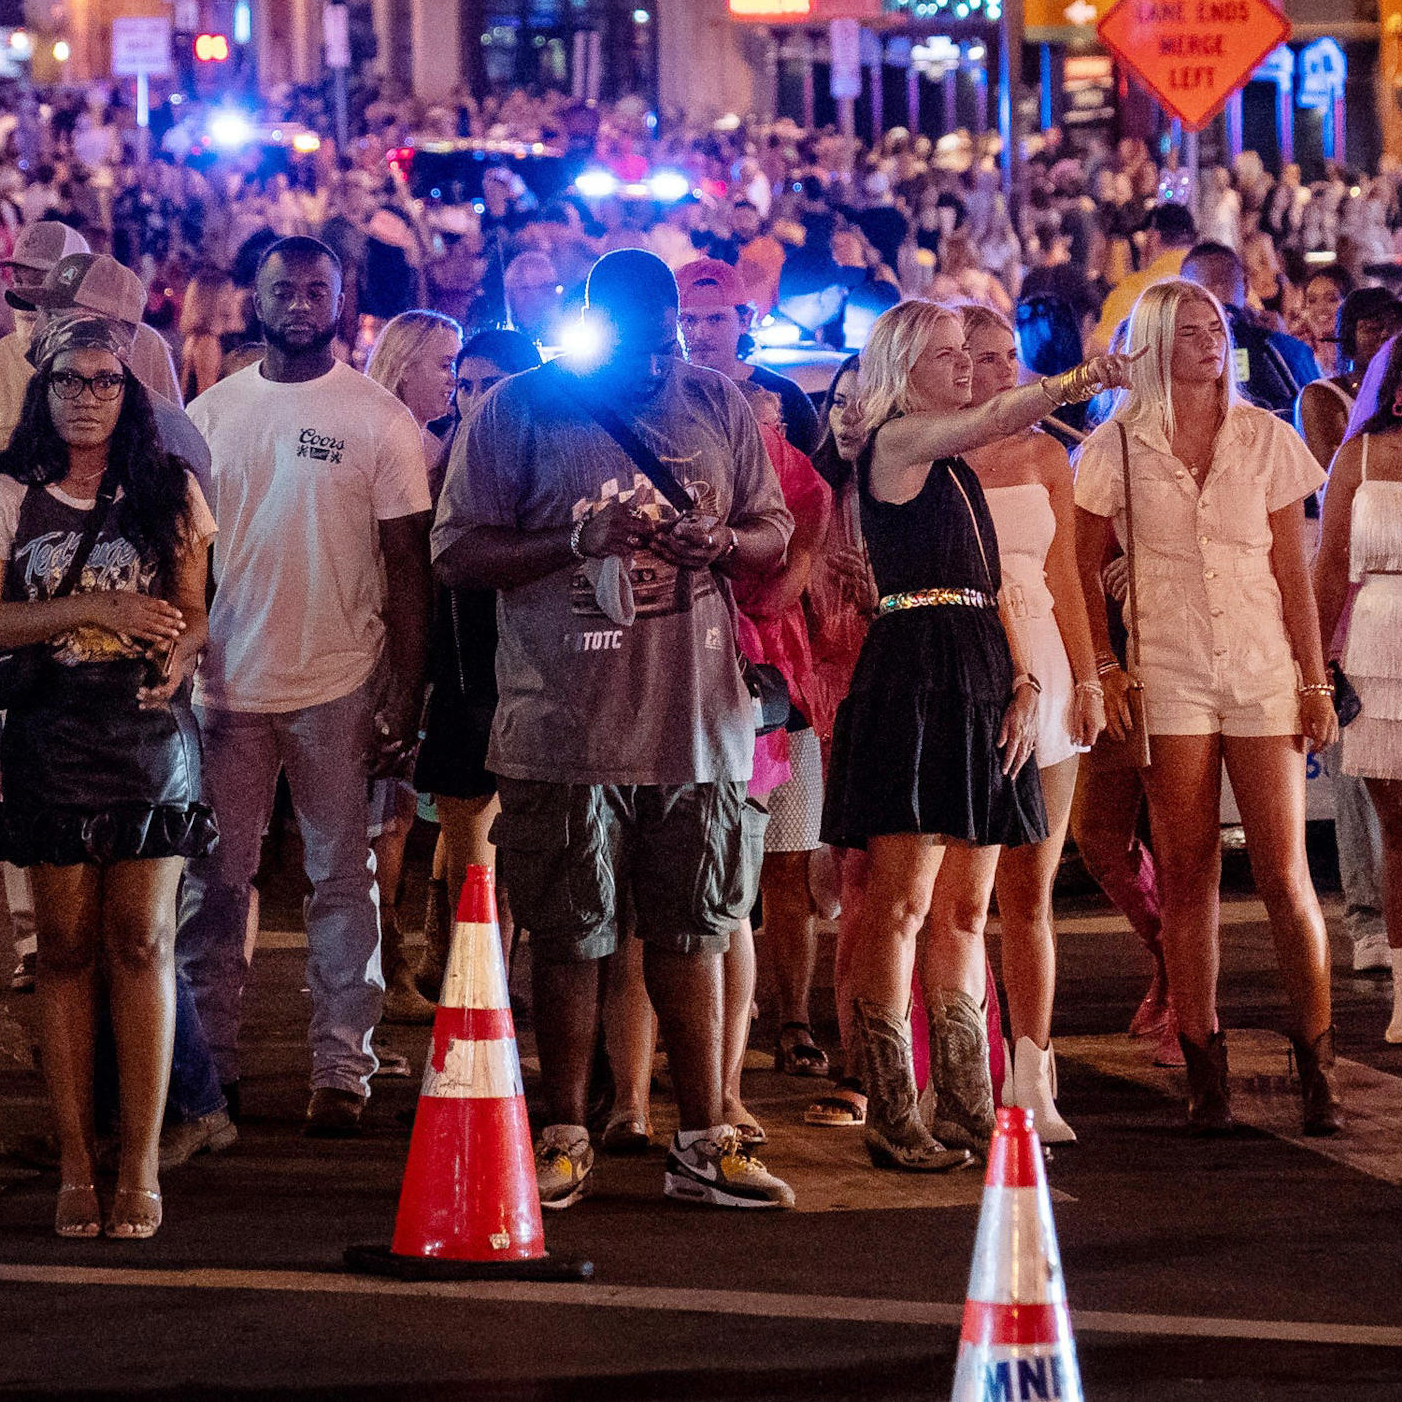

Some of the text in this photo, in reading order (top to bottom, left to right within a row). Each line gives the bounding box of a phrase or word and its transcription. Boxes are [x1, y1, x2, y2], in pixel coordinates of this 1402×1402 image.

[1135, 0, 1248, 22] LANE ENDS
[1158, 35, 1224, 55] MERGE
[1169, 66, 1215, 89] LEFT
[299, 428, 345, 450] Coors
